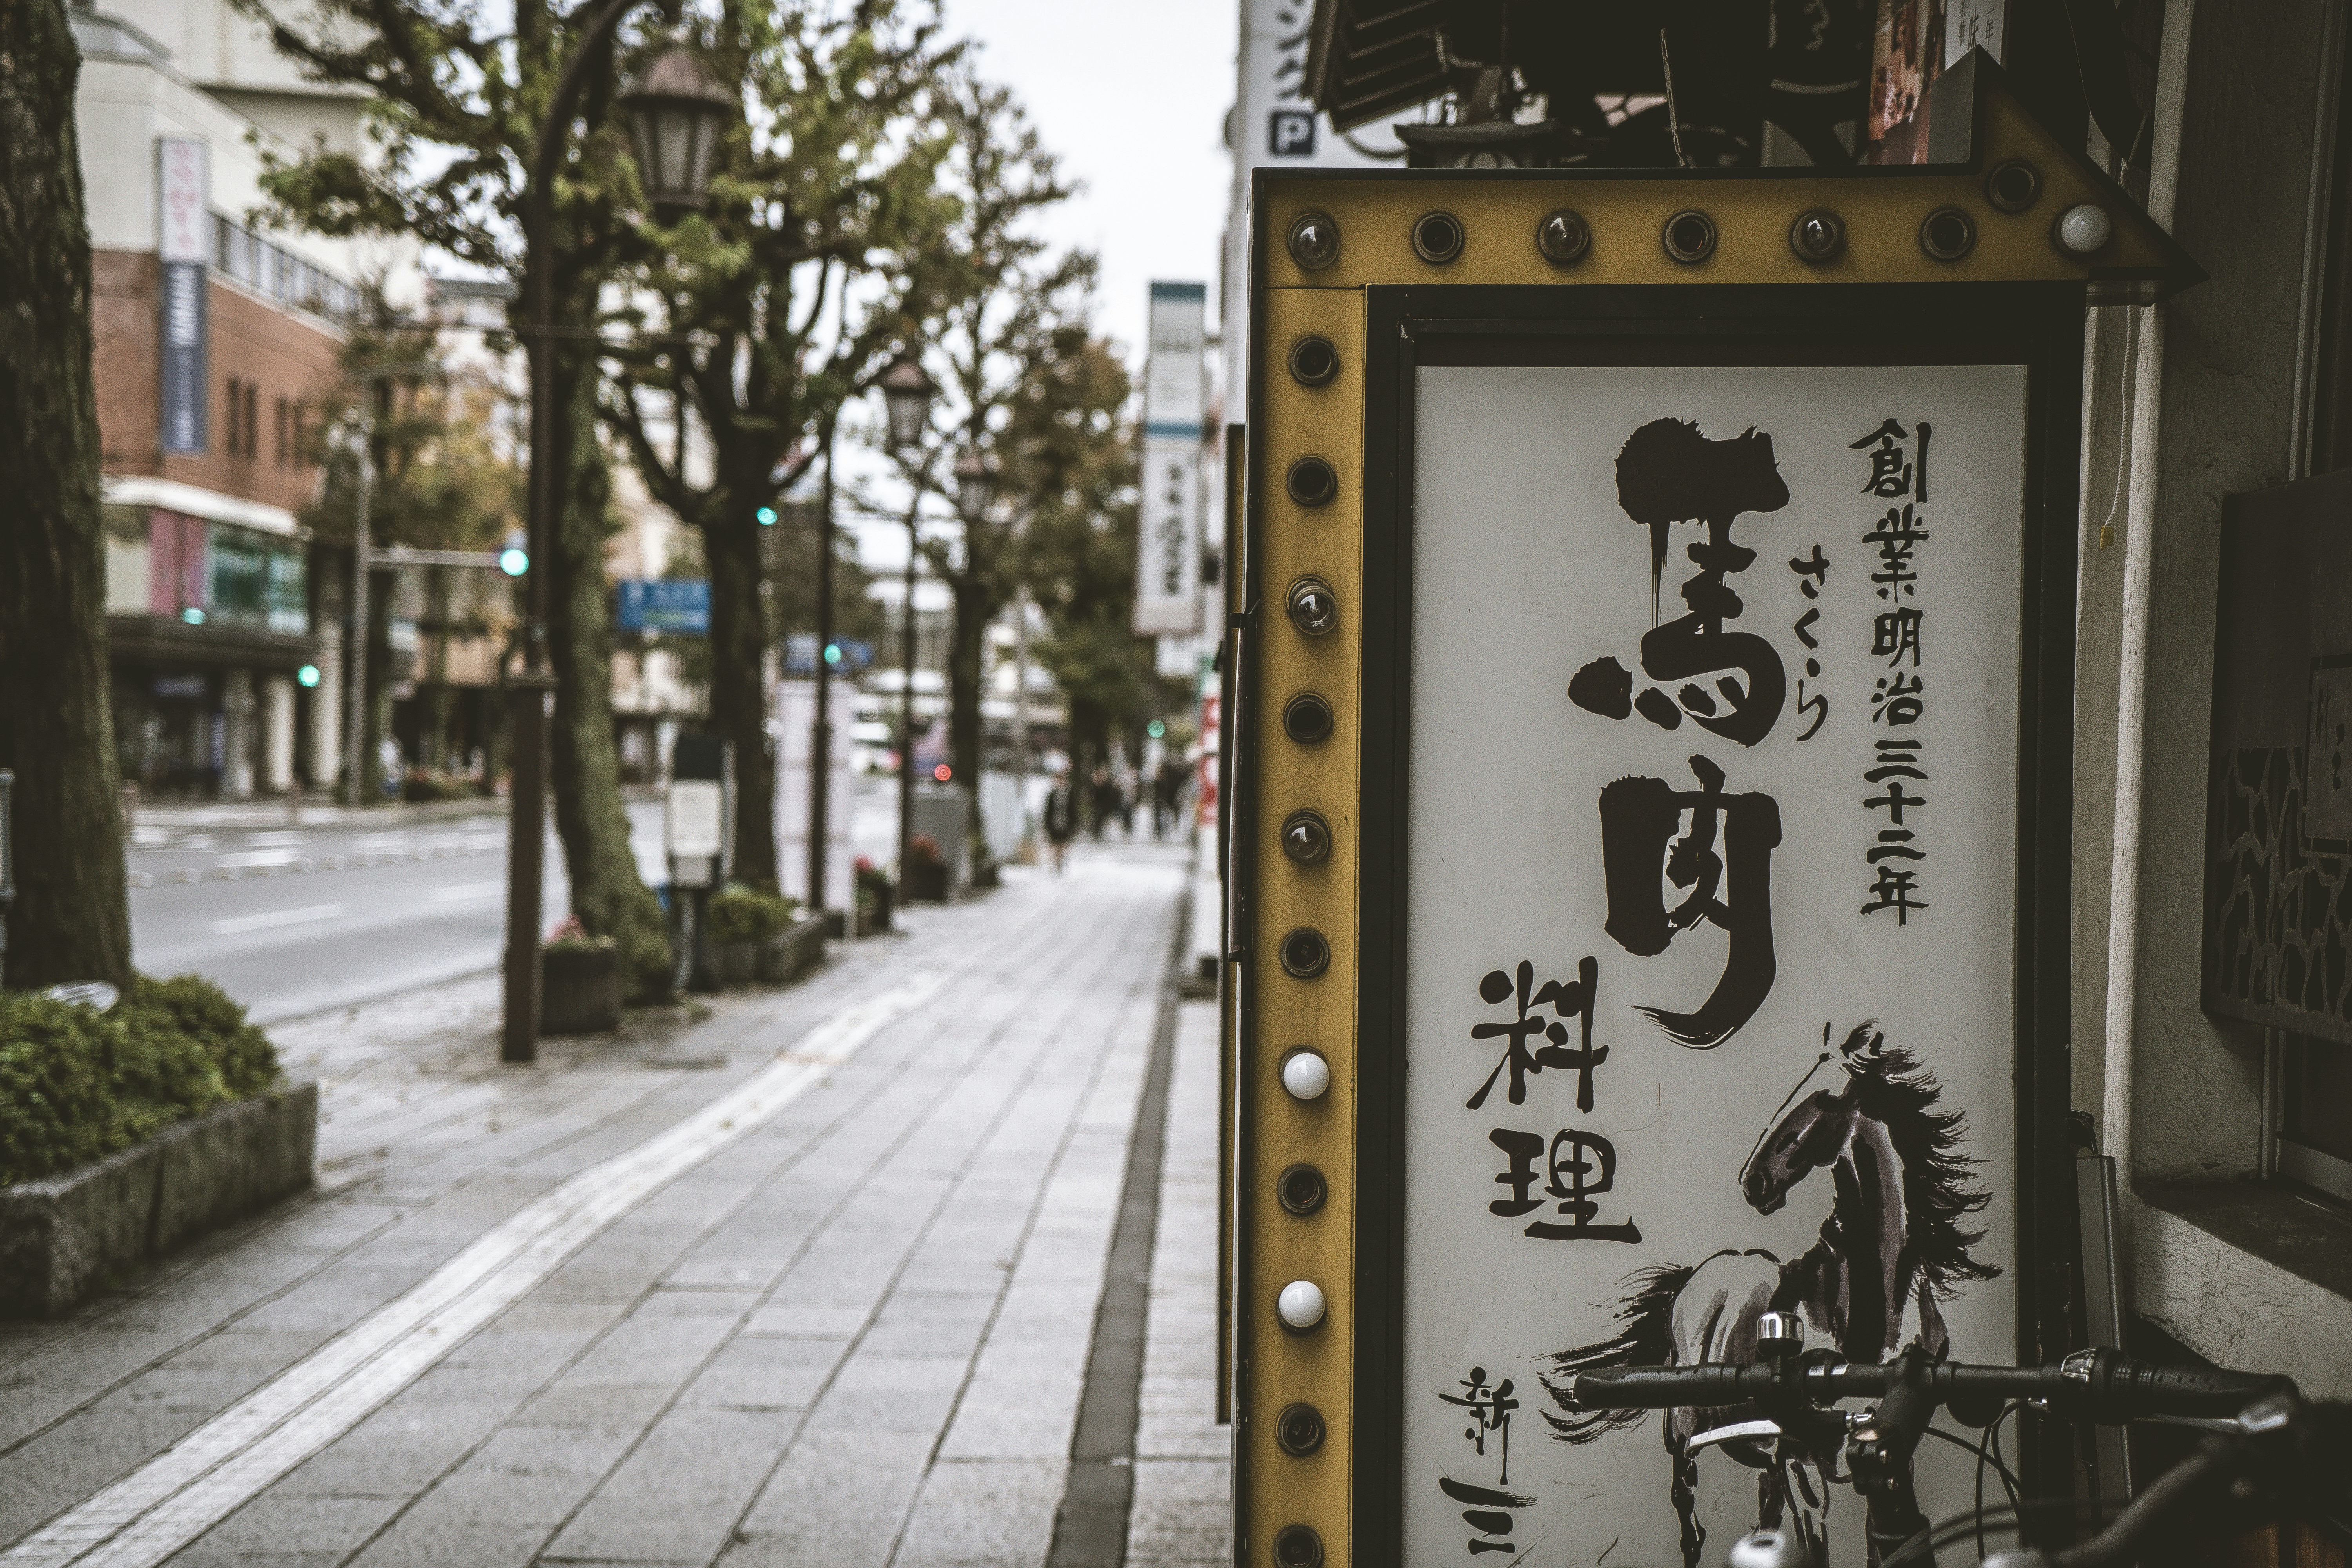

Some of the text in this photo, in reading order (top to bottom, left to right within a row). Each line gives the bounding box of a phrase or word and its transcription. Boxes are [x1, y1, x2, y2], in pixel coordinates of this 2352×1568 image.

[1276, 115, 1310, 152] P
[1568, 416, 1791, 1051] 馬肉
[1788, 544, 1830, 742] さくら
[1849, 417, 1933, 926] 創業明治三十二年
[1467, 956, 1643, 1244] 料理
